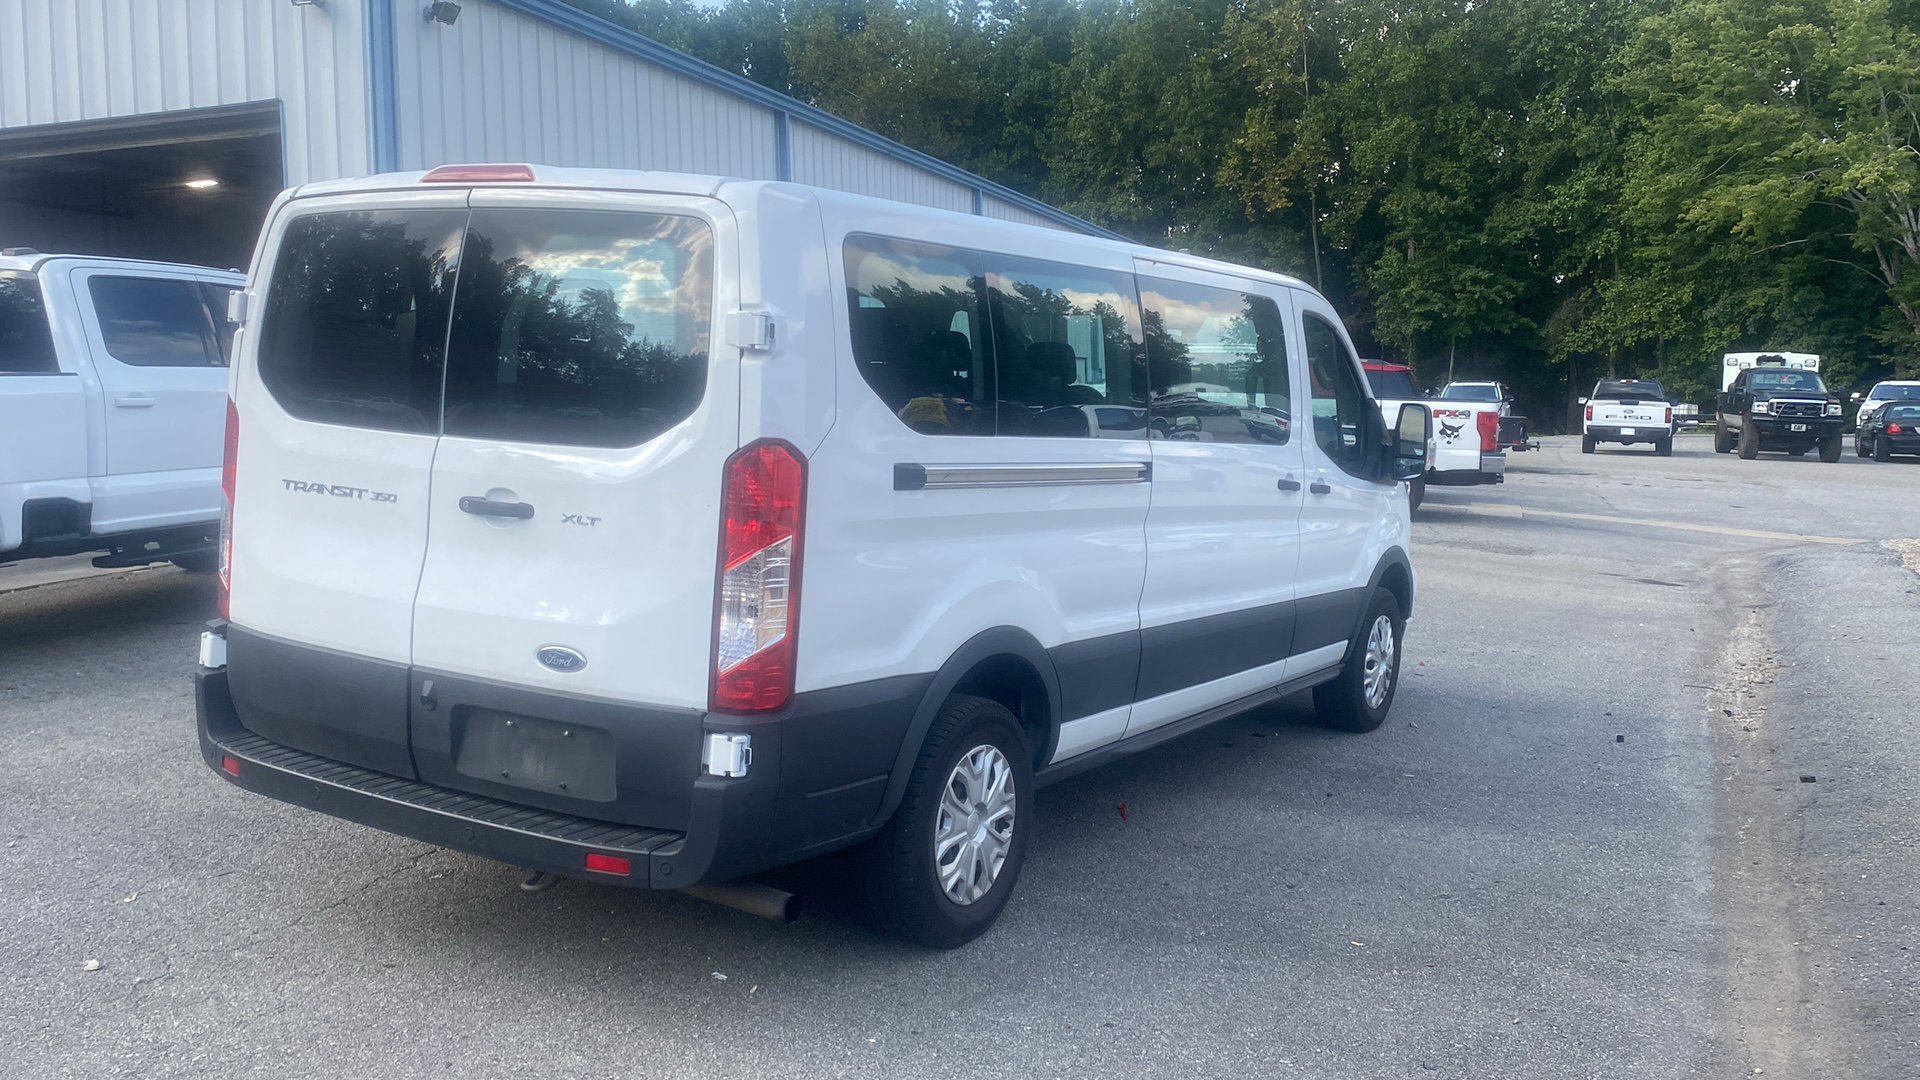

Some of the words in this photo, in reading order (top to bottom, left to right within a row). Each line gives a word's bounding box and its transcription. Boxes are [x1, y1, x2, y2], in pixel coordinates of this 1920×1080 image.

[1433, 409, 1471, 418] FX4
[282, 479, 369, 500] TRANSIT
[370, 491, 398, 504] 350
[561, 513, 602, 527] XLT
[545, 652, 573, 667] Ford
